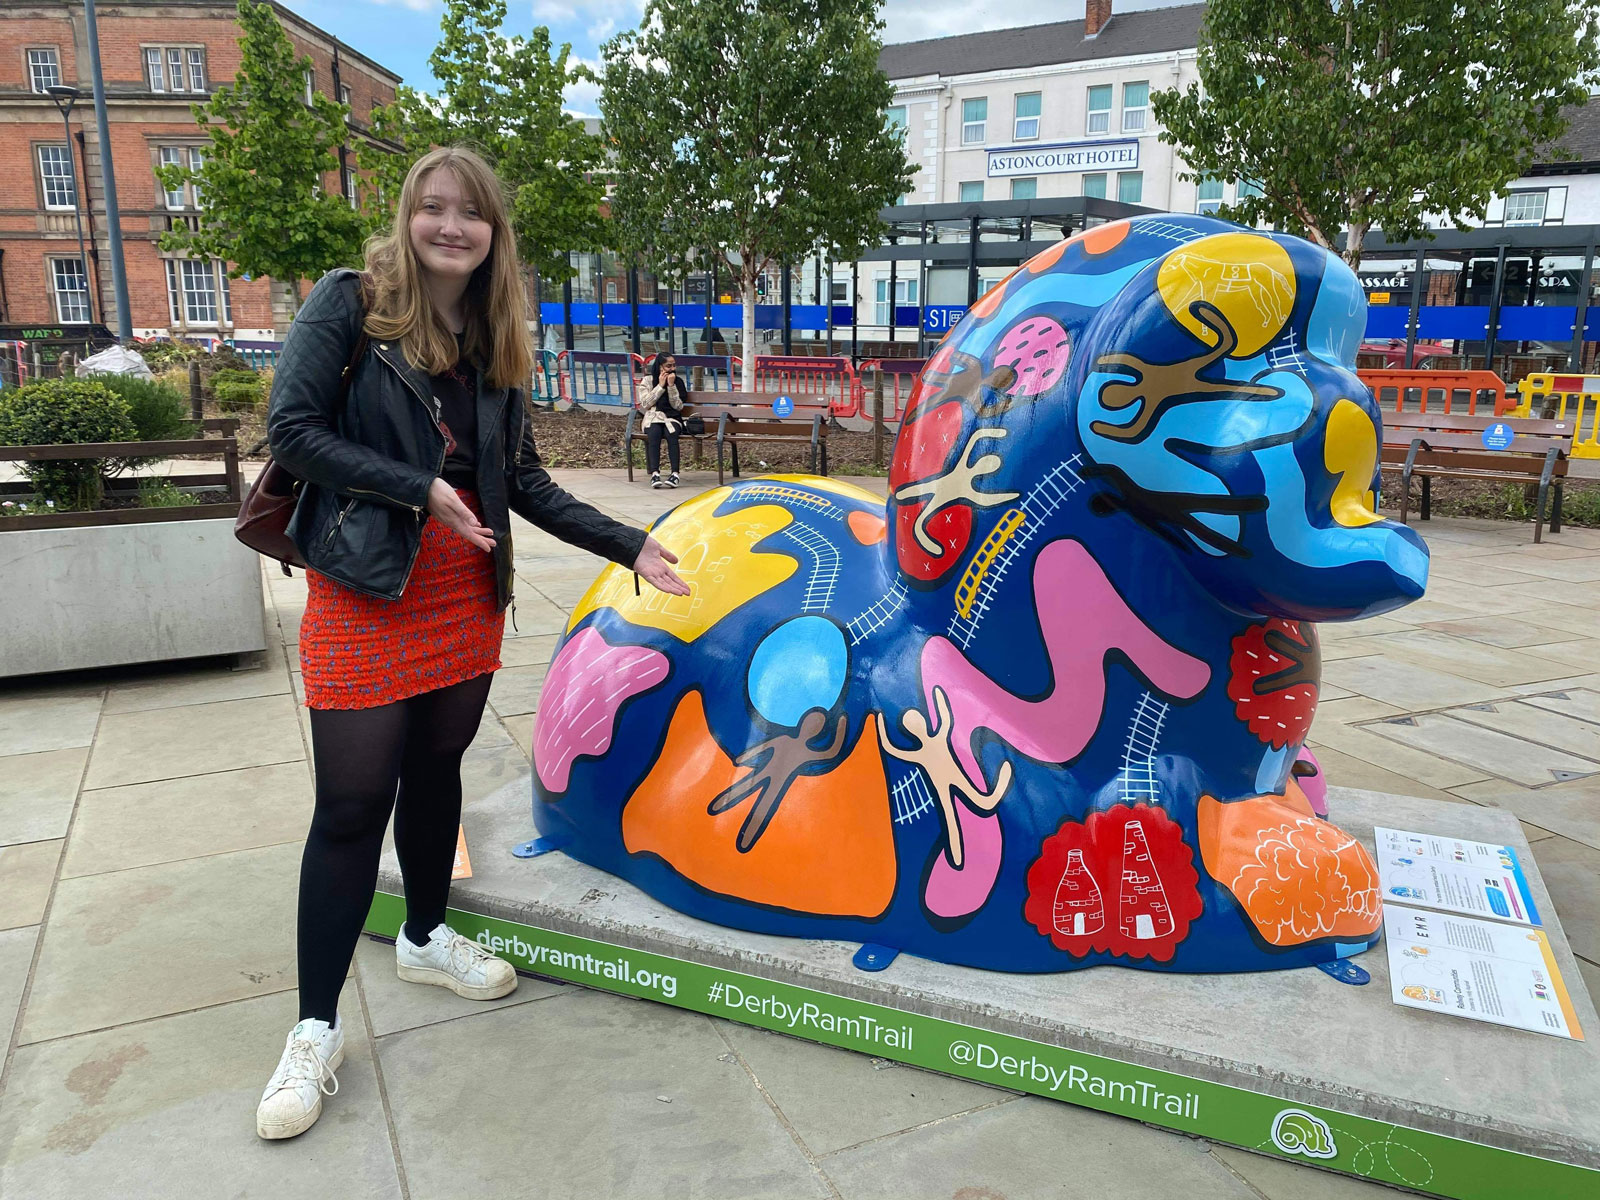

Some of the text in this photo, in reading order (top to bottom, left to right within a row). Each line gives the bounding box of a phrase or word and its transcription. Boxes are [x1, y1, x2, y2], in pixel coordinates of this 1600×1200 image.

[1086, 149, 1136, 164] HOTEL
[1359, 277, 1409, 288] ASSAGE
[1539, 276, 1571, 287] SPA
[929, 309, 947, 328] S1
[476, 928, 1199, 1120] derbyramtrail.org #DerbyRamTrail @DerbyRamTrail
